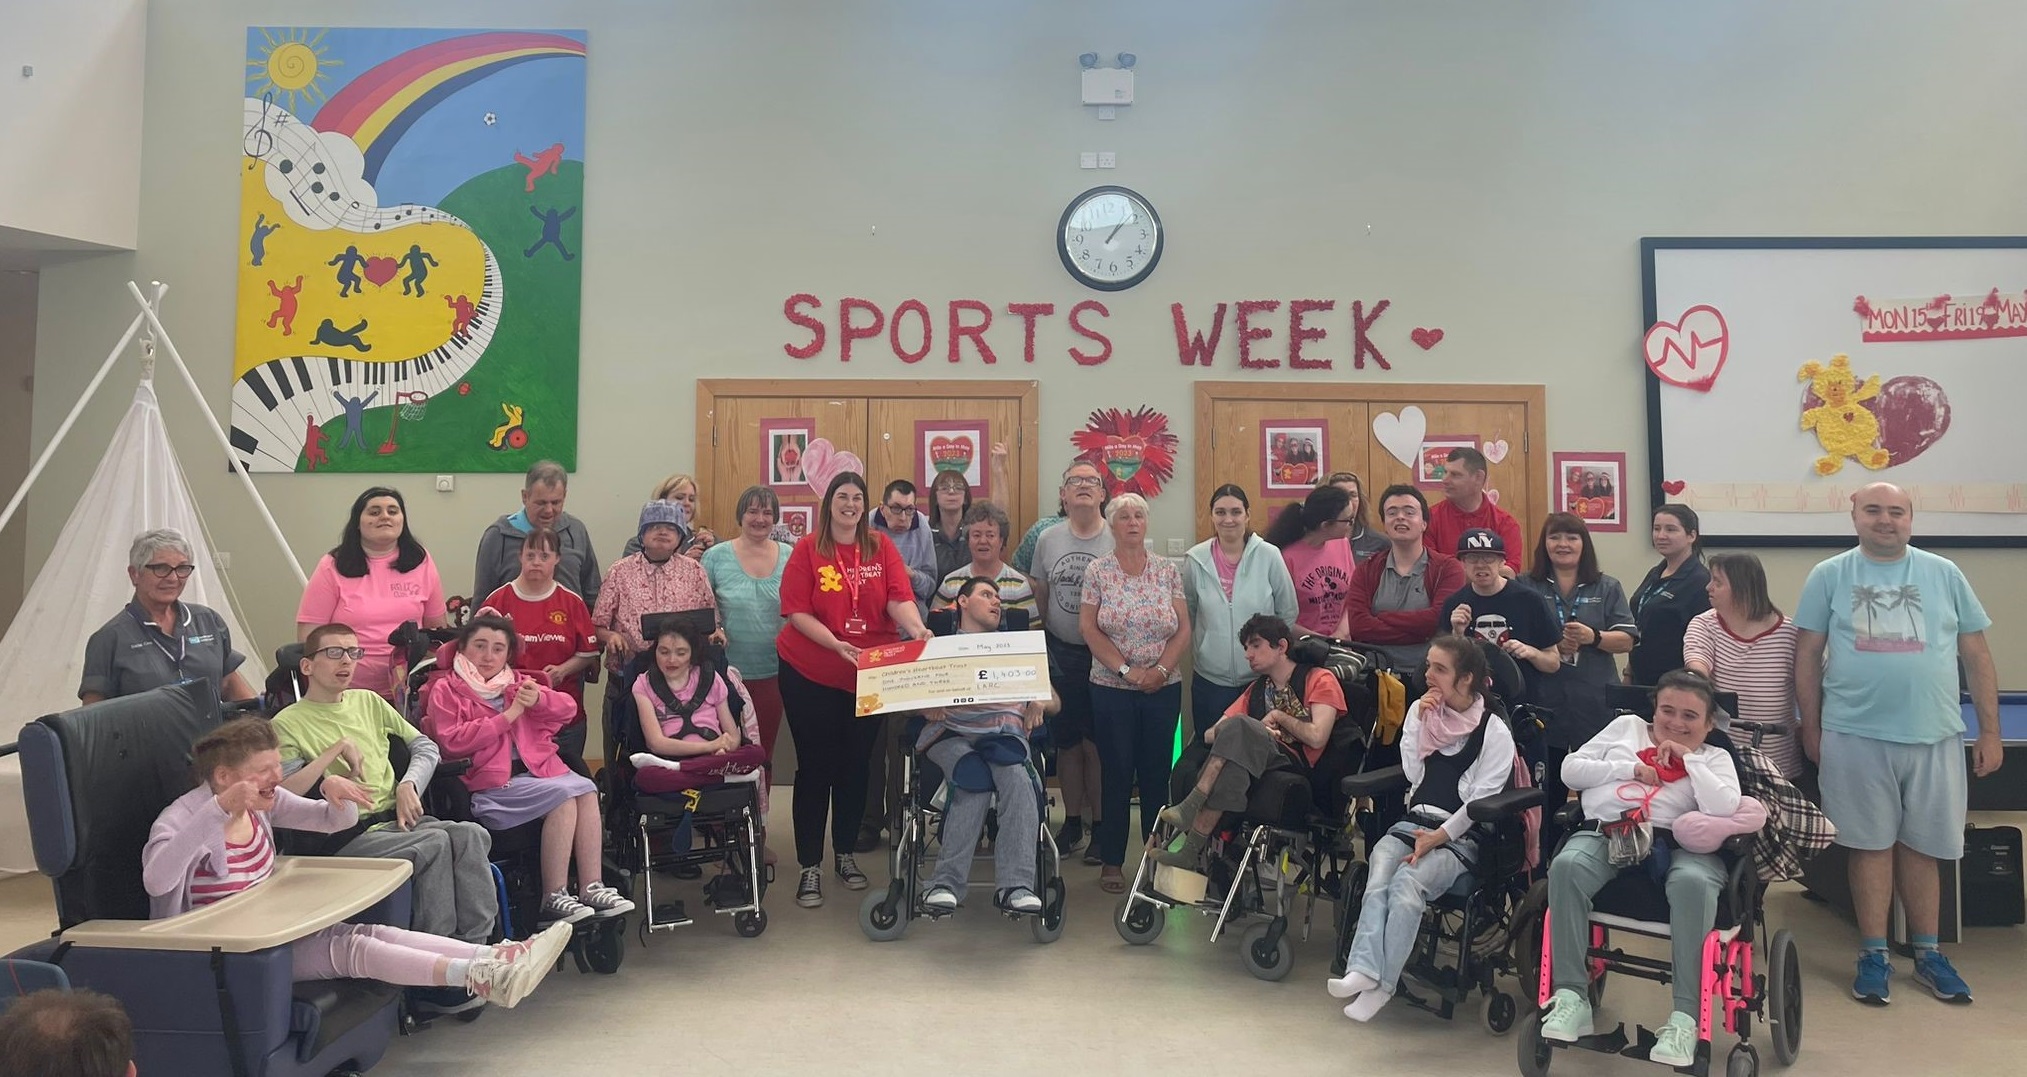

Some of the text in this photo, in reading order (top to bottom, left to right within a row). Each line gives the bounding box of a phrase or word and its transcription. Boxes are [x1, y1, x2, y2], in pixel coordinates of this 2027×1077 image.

[1132, 213, 1139, 224] 2
[1081, 221, 1092, 232] 10
[1075, 234, 1084, 245] 9
[1140, 229, 1147, 240] 3
[1081, 249, 1090, 260] 8
[1134, 244, 1143, 255] 4
[1095, 258, 1103, 269] 7
[1109, 261, 1118, 273] 6
[1125, 256, 1134, 268] 5
[1868, 305, 1908, 330] MON
[784, 293, 1391, 370] SPORTS WEEK
[1467, 532, 1493, 549] NY
[1061, 555, 1092, 567] AUTHEN
[1301, 565, 1350, 591] THE ORIGINAL
[978, 670, 988, 680] £
